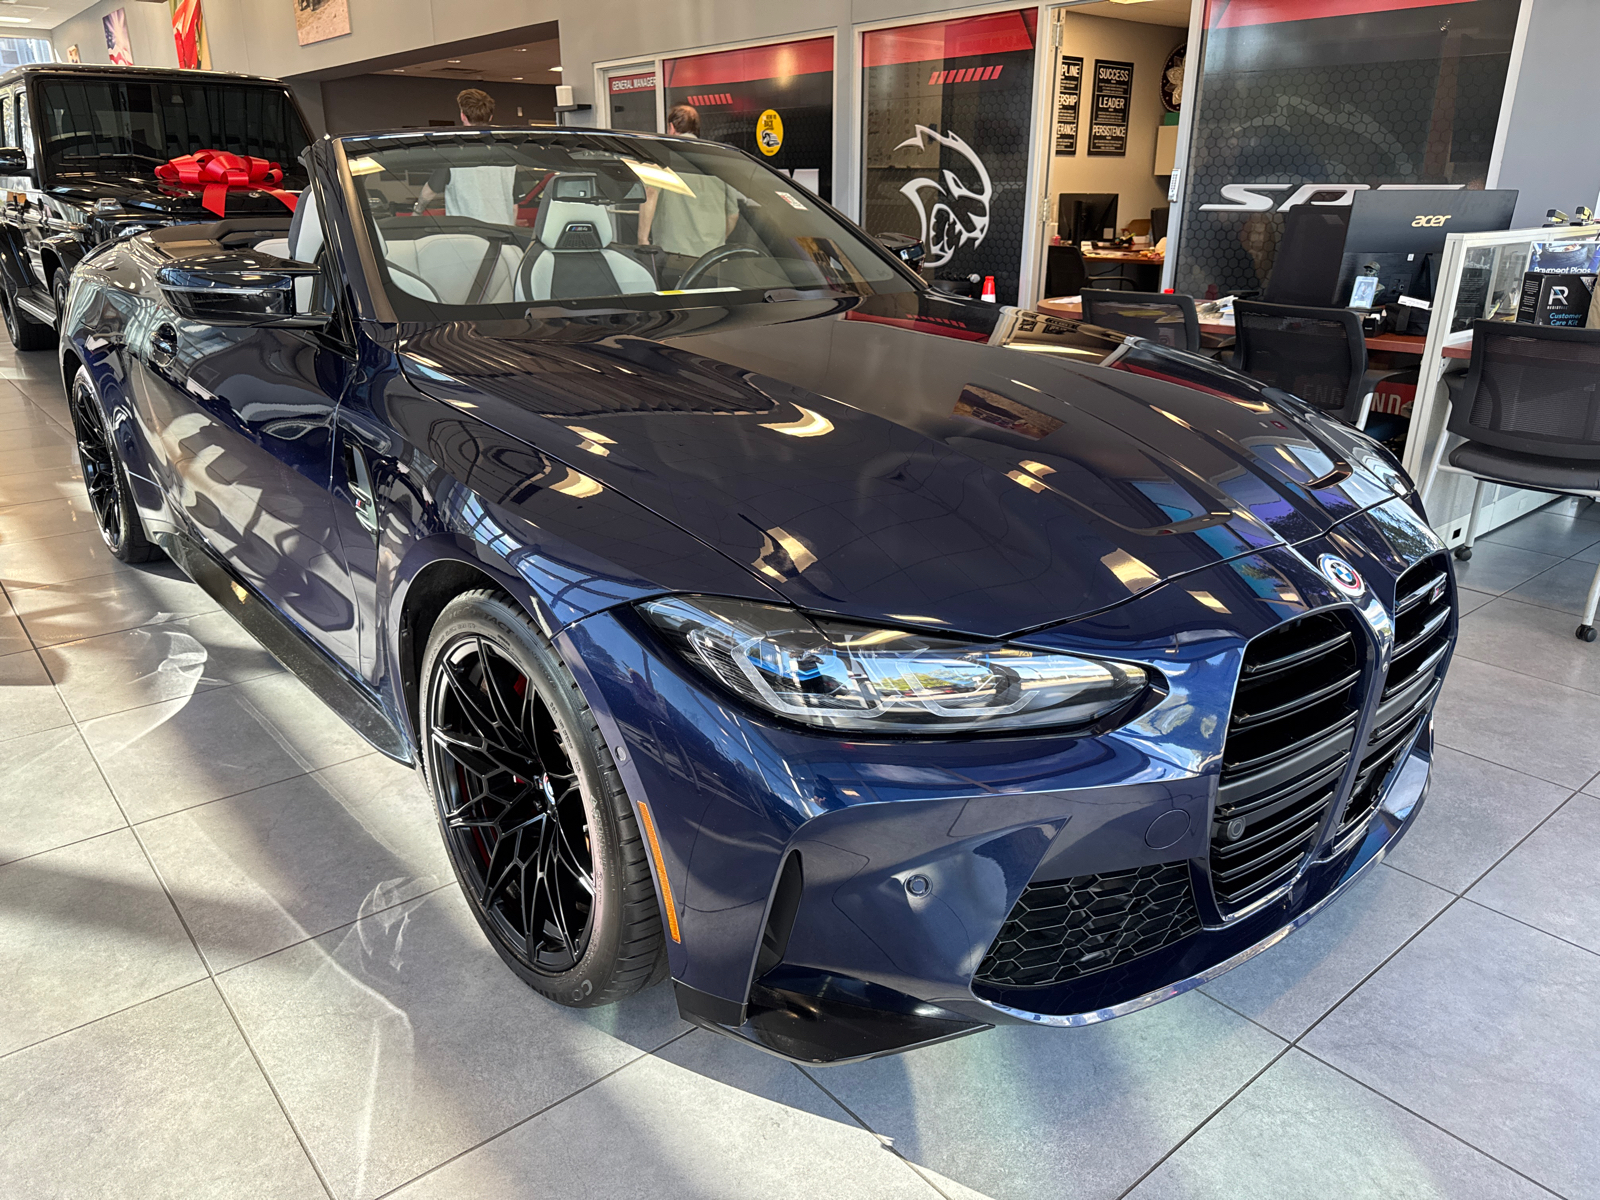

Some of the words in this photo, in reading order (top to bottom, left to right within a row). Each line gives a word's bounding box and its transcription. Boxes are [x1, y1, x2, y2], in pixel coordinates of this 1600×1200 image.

[1099, 67, 1129, 81] SUCCESS
[612, 80, 633, 90] GENERAL
[1099, 96, 1125, 109] LEADER
[1092, 125, 1126, 137] PERSISTENCE
[1411, 214, 1452, 228] acer
